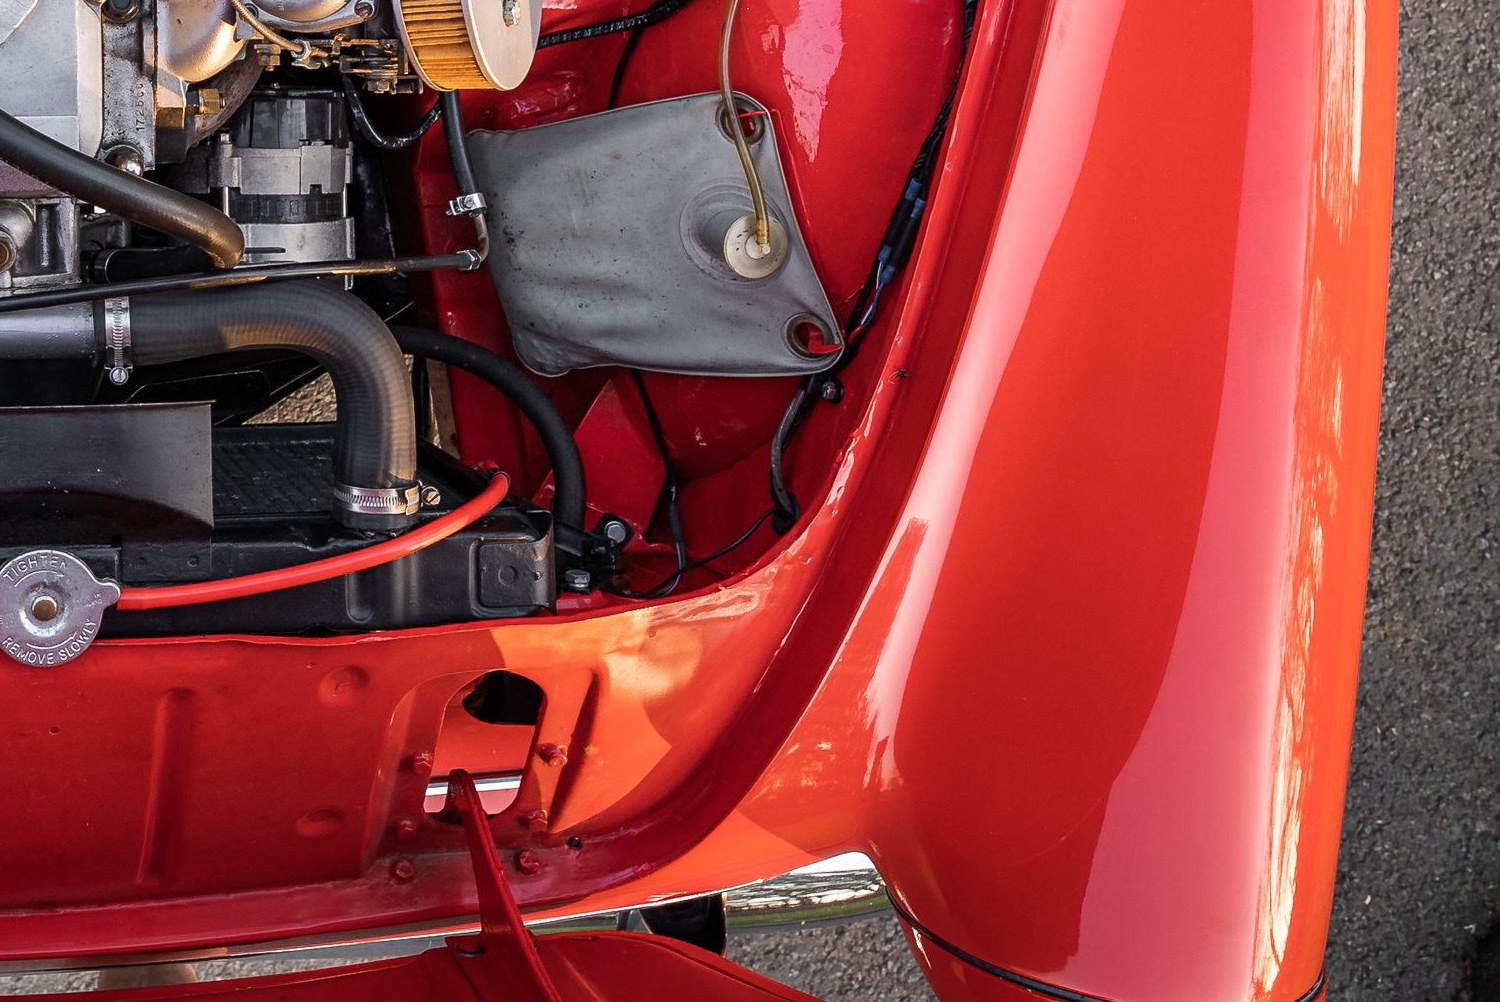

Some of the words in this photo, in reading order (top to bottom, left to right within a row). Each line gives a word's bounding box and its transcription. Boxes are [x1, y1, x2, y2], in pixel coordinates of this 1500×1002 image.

[2, 554, 70, 583] TIGHTEN
[1, 635, 56, 665] REMOVE
[57, 618, 98, 661] SLOWLY
